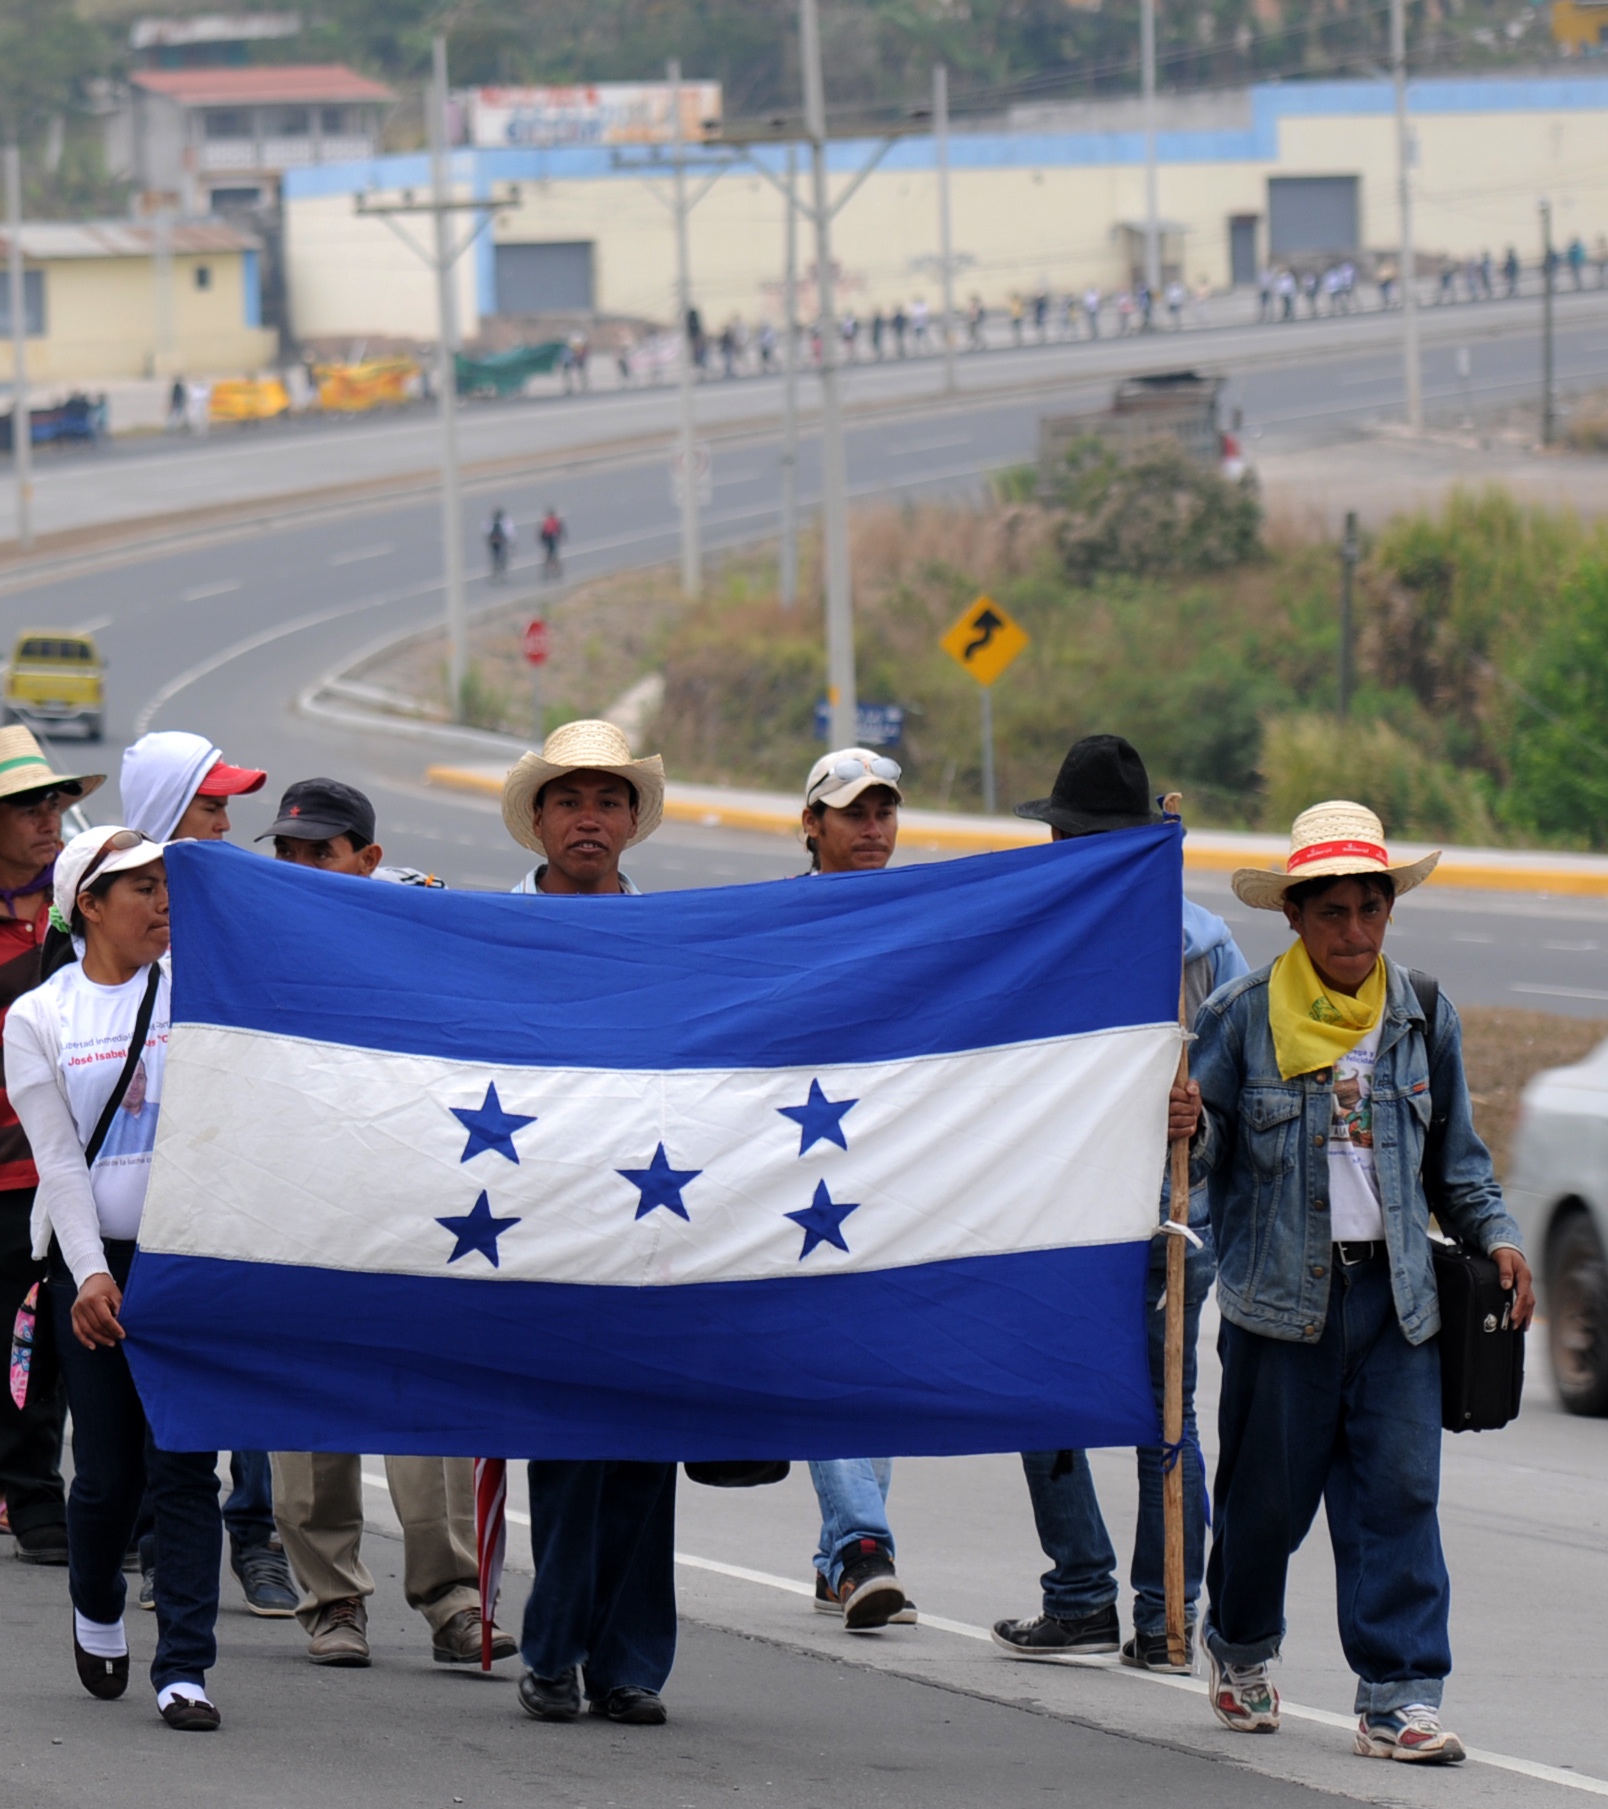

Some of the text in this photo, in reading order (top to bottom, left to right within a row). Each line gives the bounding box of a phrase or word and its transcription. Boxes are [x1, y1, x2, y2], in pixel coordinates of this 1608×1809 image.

[95, 1032, 134, 1044] inmediat
[68, 1053, 93, 1067] José
[95, 1048, 128, 1061] Isabel
